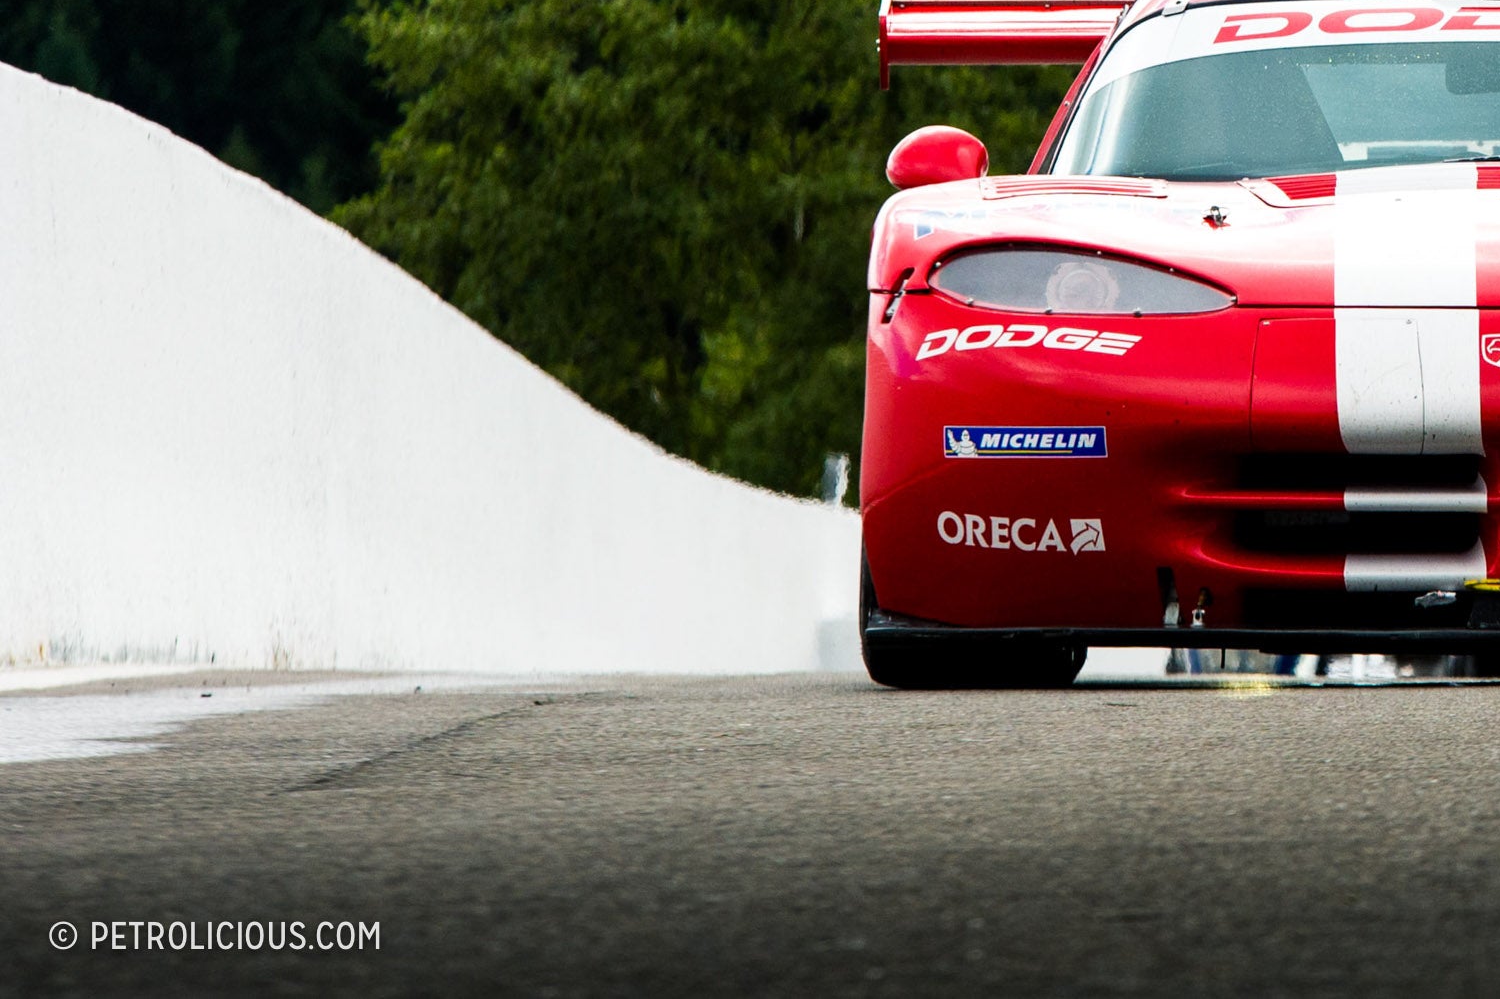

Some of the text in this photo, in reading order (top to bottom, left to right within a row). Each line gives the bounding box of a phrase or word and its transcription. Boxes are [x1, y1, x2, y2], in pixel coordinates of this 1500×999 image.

[915, 324, 1142, 361] DODGE
[979, 433, 1096, 448] MICHELIN
[936, 510, 1066, 552] ORECA
